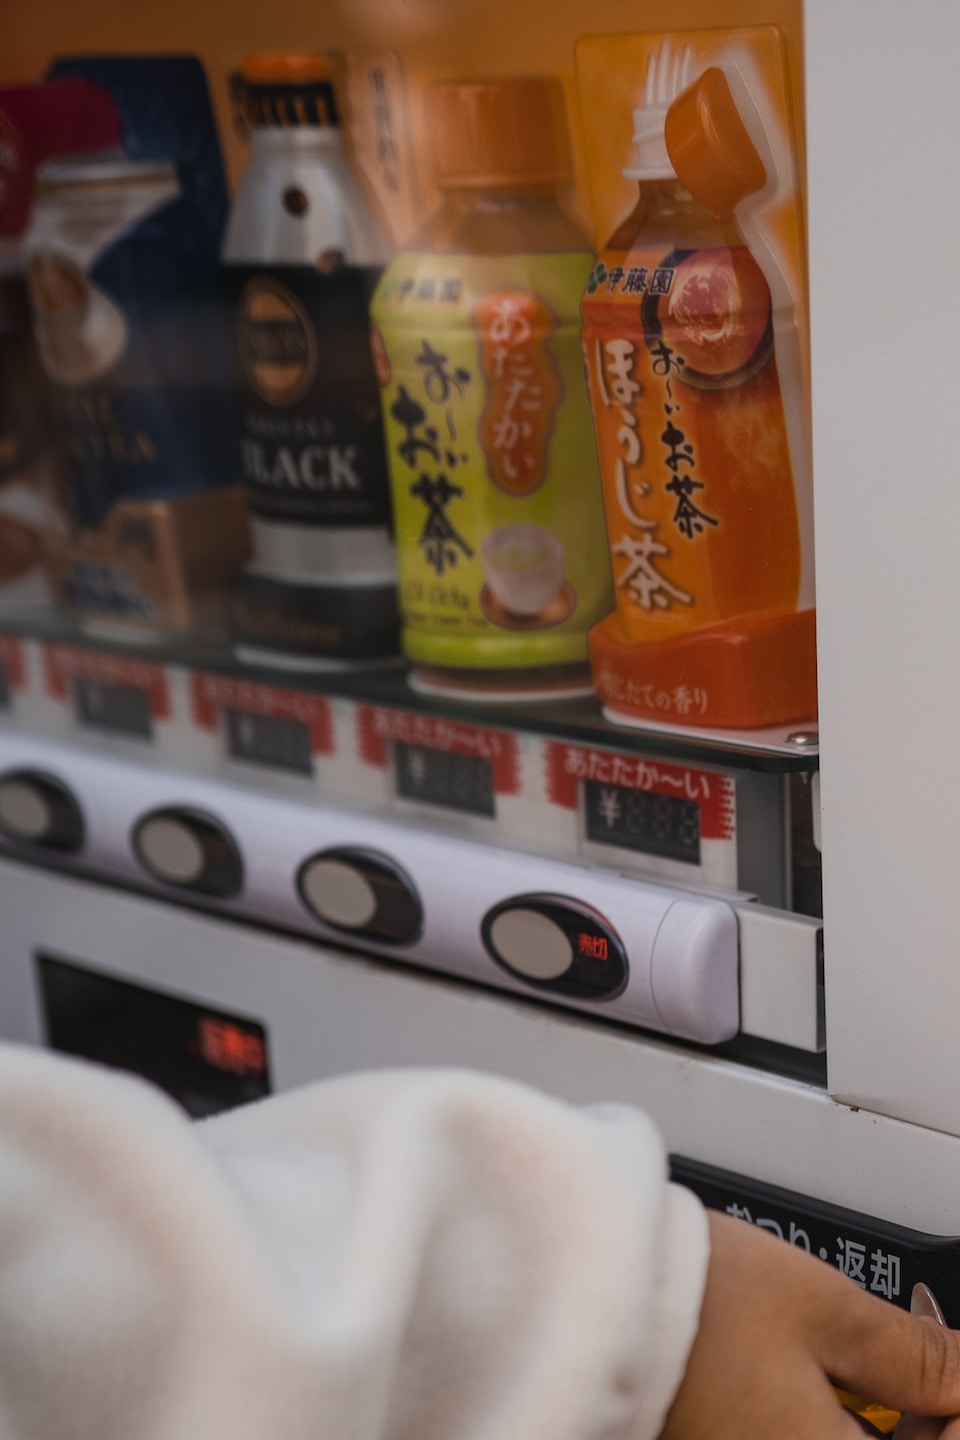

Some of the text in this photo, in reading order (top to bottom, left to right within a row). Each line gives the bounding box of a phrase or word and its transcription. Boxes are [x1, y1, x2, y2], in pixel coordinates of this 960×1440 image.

[608, 266, 675, 295] 伊藤園
[596, 338, 693, 611] ほうじ茶
[564, 749, 711, 799] あたたか〜い
